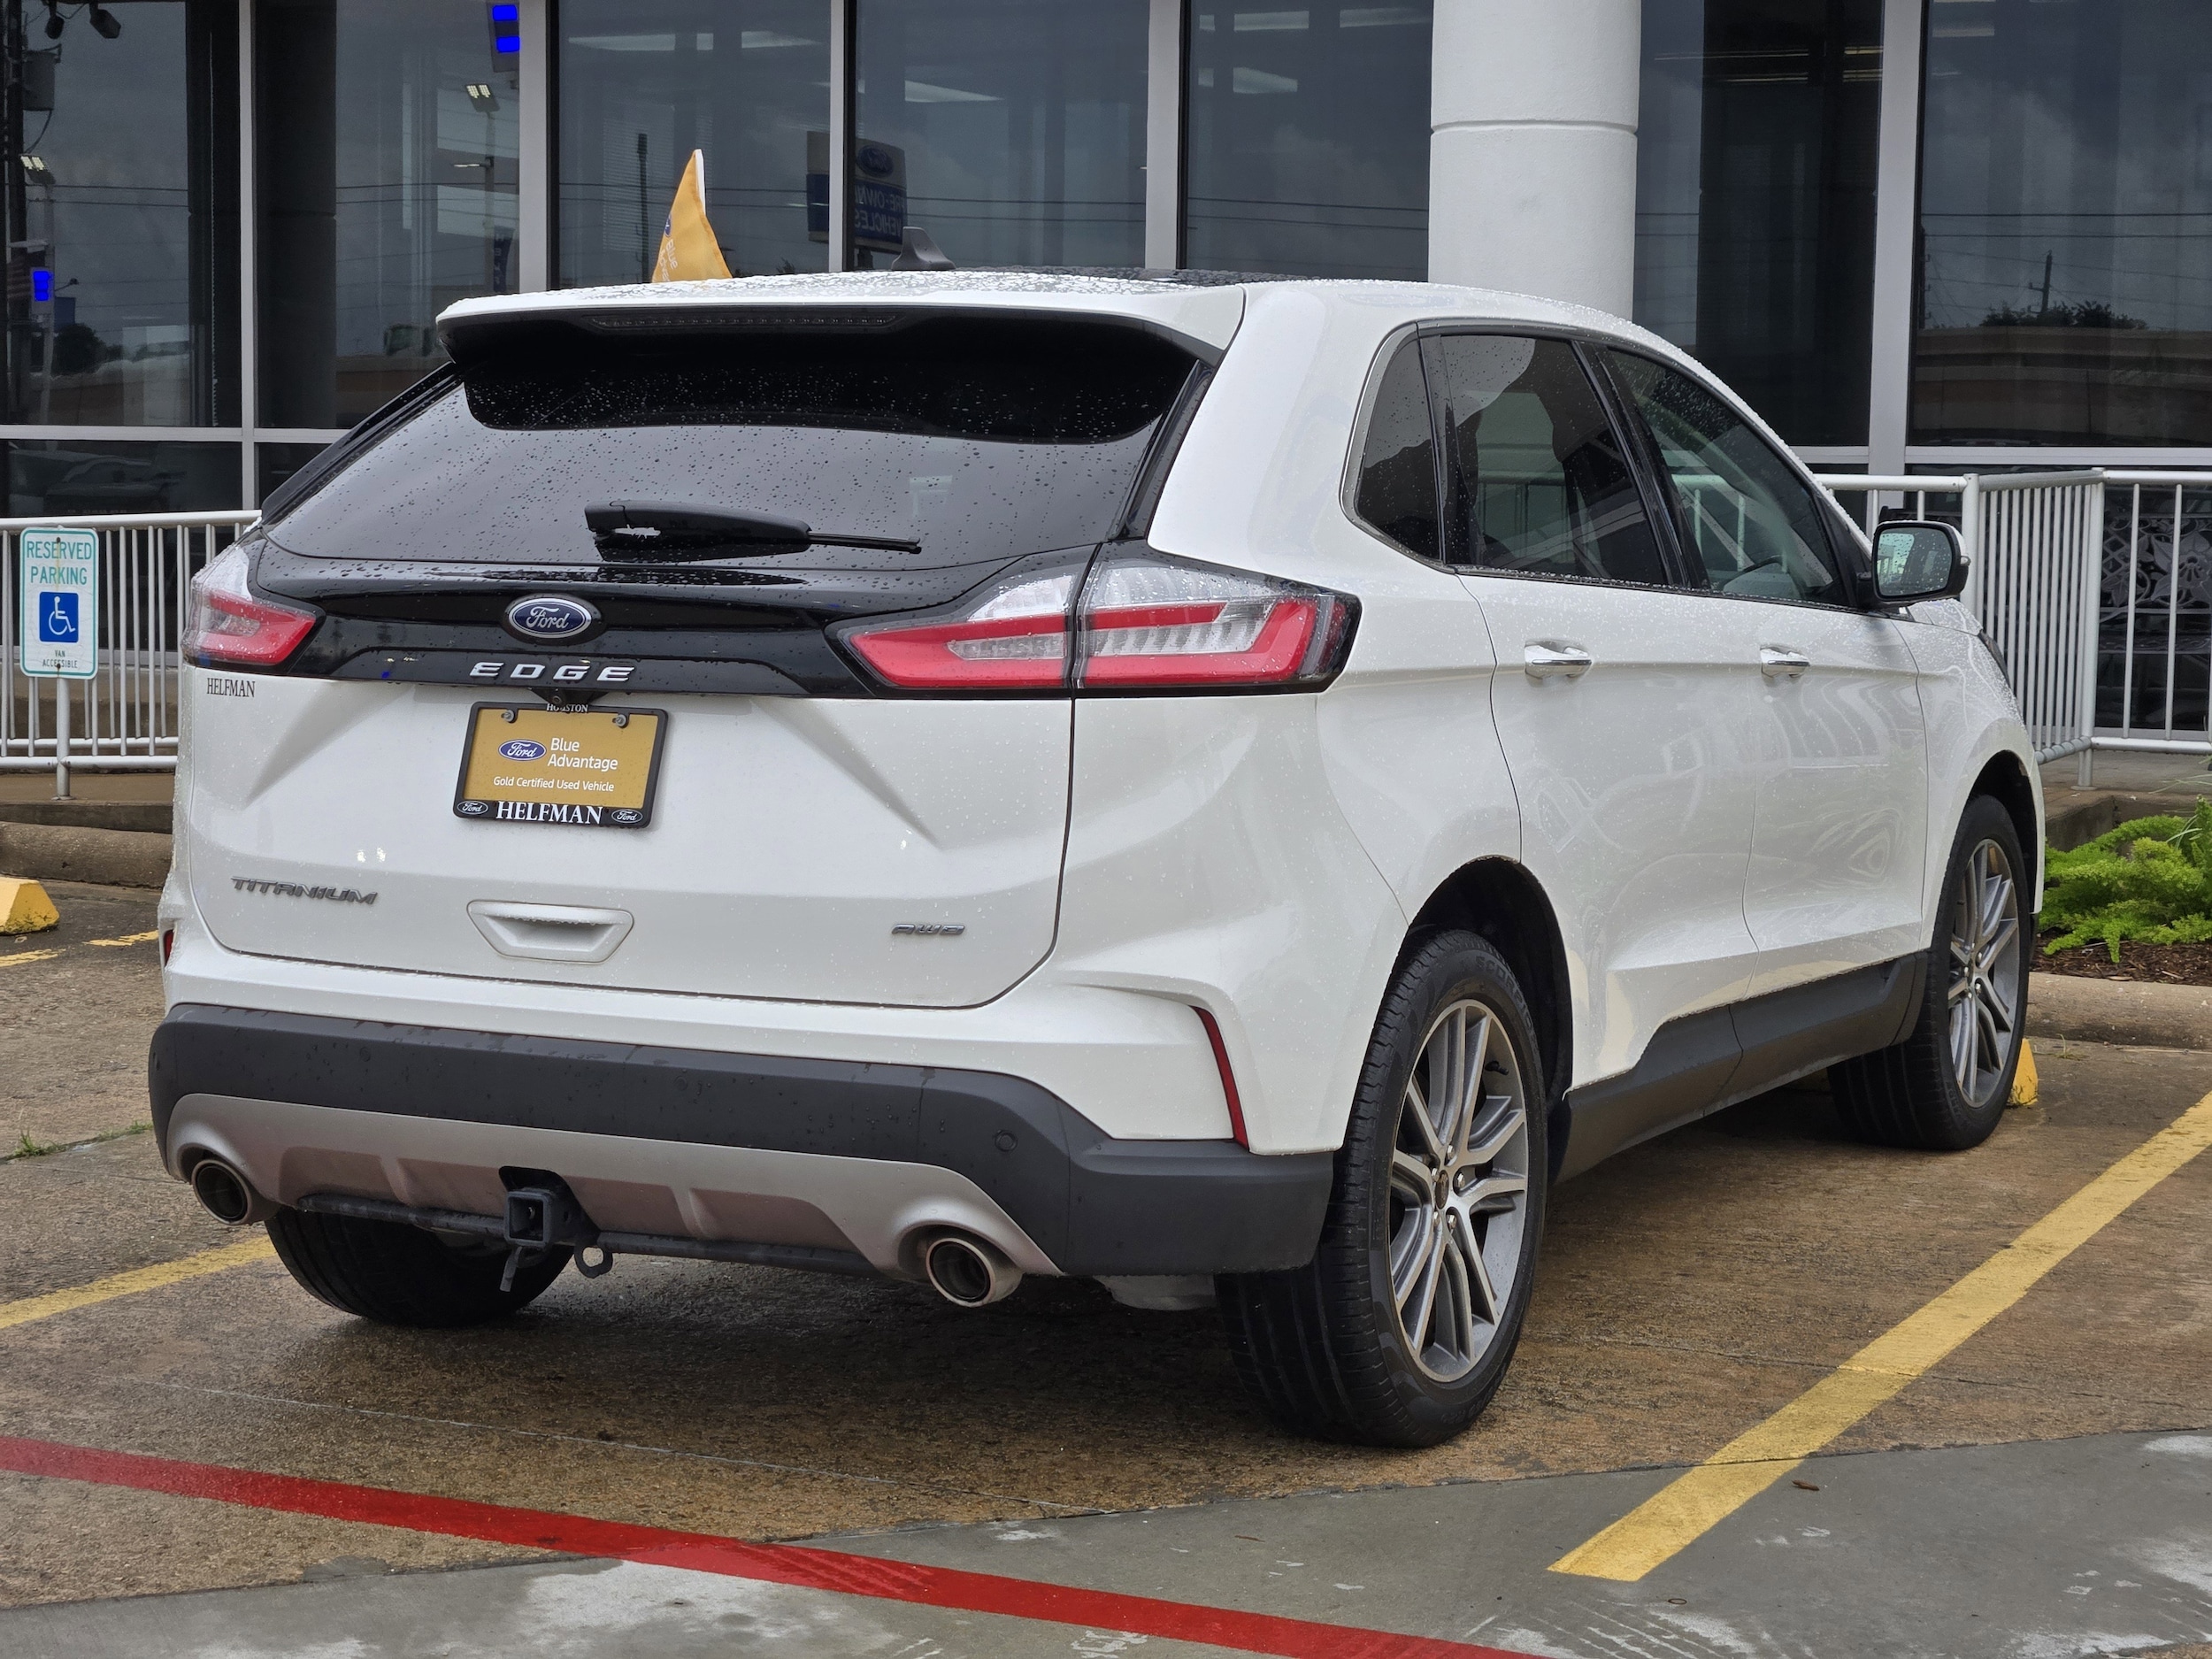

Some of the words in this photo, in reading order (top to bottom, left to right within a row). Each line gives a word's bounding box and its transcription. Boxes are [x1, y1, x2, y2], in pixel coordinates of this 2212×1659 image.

[27, 541, 92, 559] RESERVED
[31, 566, 87, 585] PARKING
[526, 605, 570, 630] Ford
[469, 661, 635, 682] EDGE
[206, 677, 257, 698] HELFMAN
[507, 743, 538, 757] Ford
[550, 738, 580, 751] Blue
[548, 755, 618, 772] Advantage
[493, 775, 514, 787] Gold
[516, 777, 554, 788] Certified
[556, 779, 580, 790] Used
[582, 780, 615, 792] Vehicle
[461, 802, 482, 814] Ford
[495, 800, 603, 826] HELFMAN
[616, 810, 637, 823] Ford
[230, 876, 379, 906] TITANIUM
[891, 923, 965, 936] AWD
